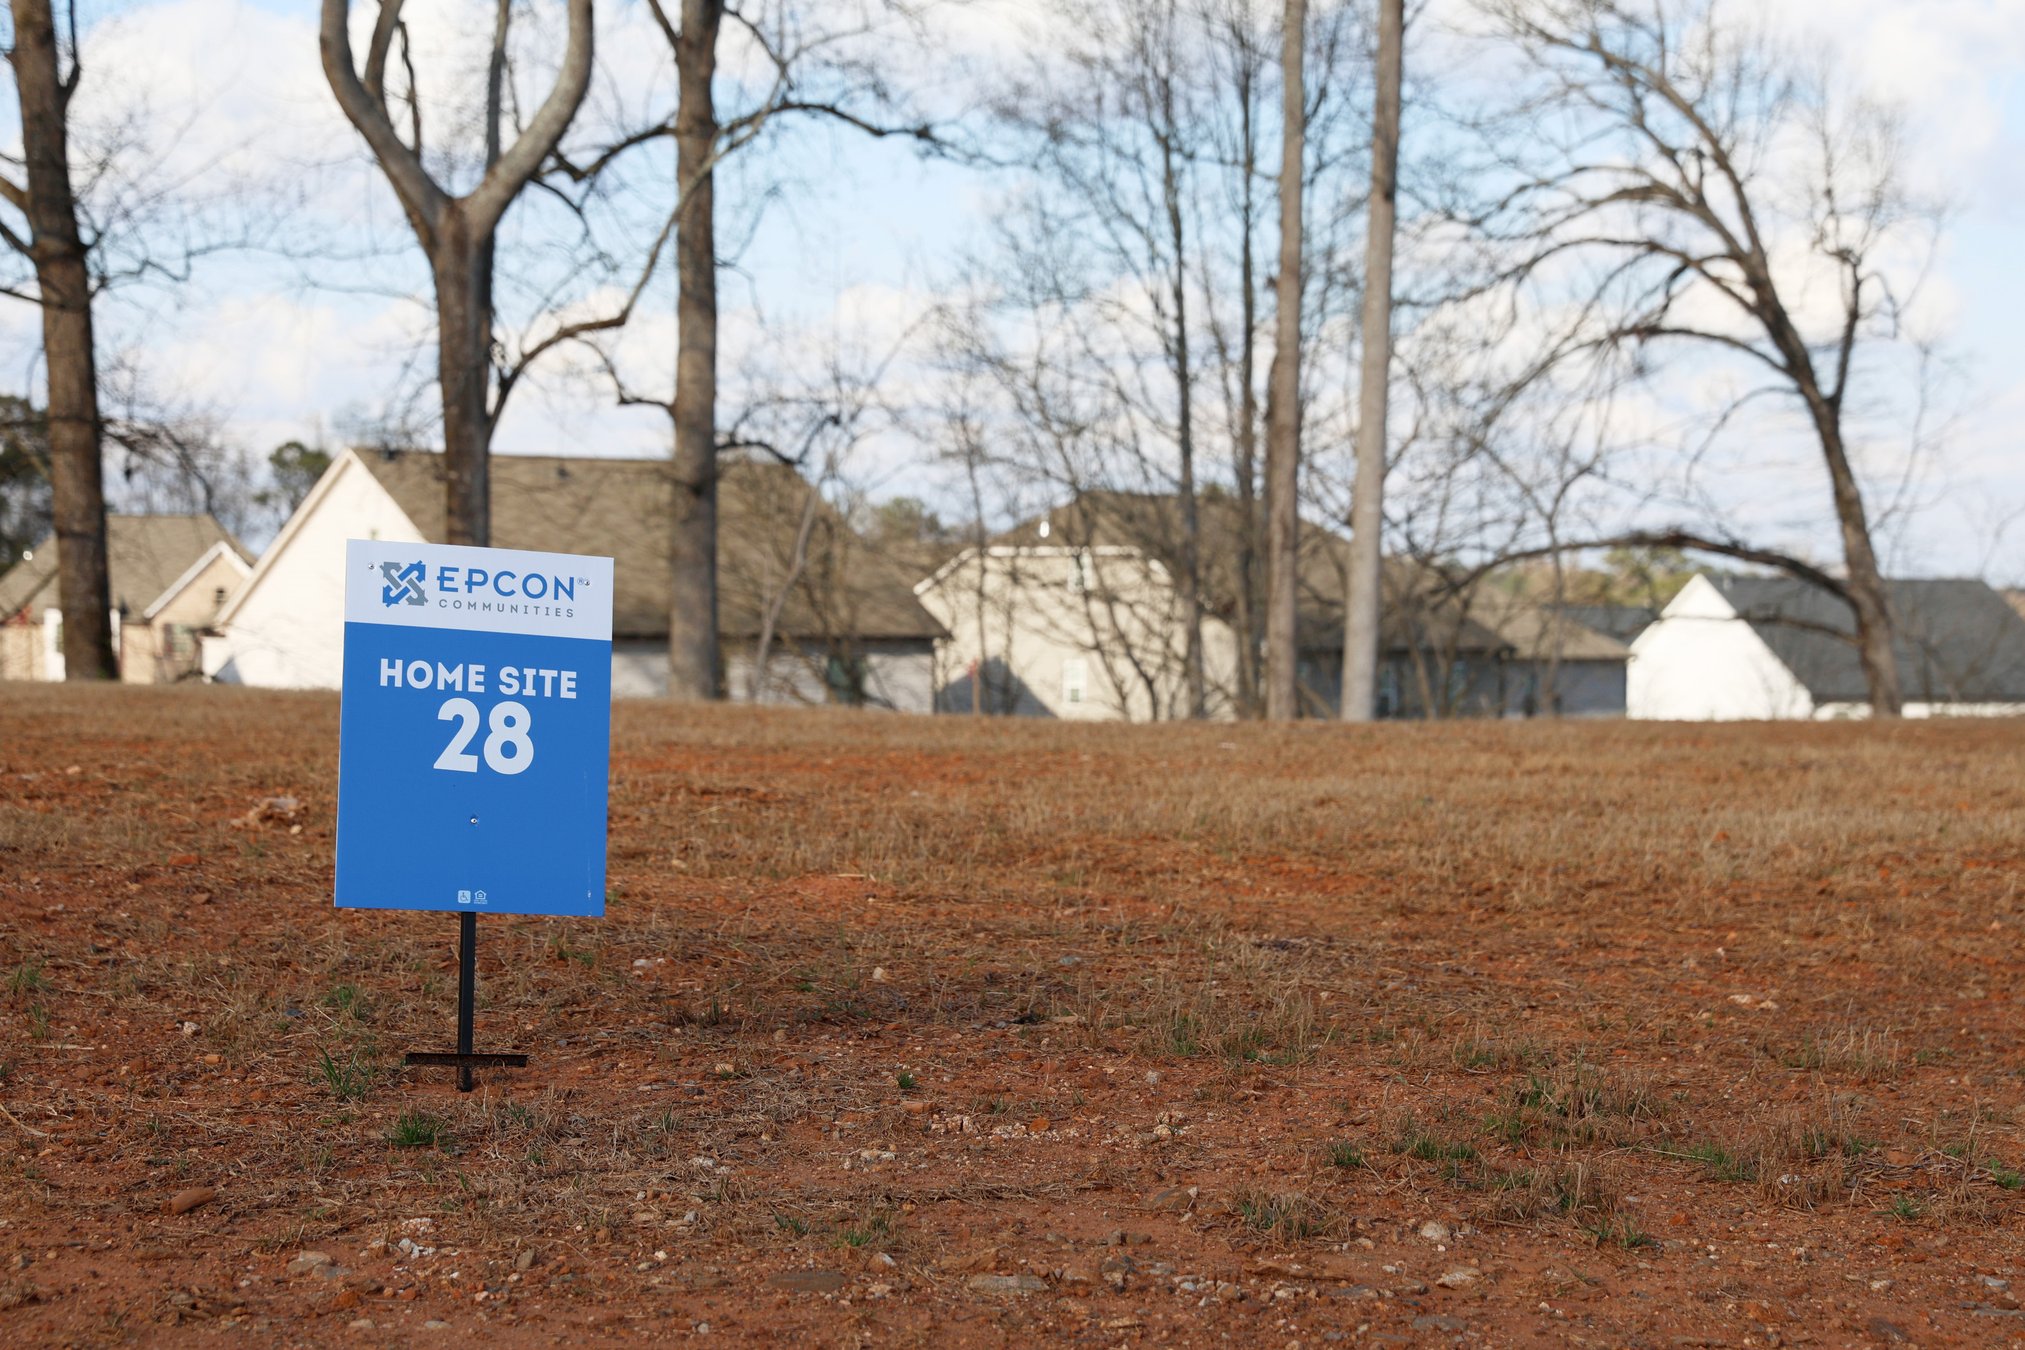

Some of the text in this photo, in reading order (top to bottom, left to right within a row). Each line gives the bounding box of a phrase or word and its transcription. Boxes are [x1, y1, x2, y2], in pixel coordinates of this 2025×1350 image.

[437, 566, 575, 602] EPCON
[439, 598, 575, 618] COMMUNITIES
[379, 658, 578, 699] HOME SITE
[433, 697, 535, 775] 28
